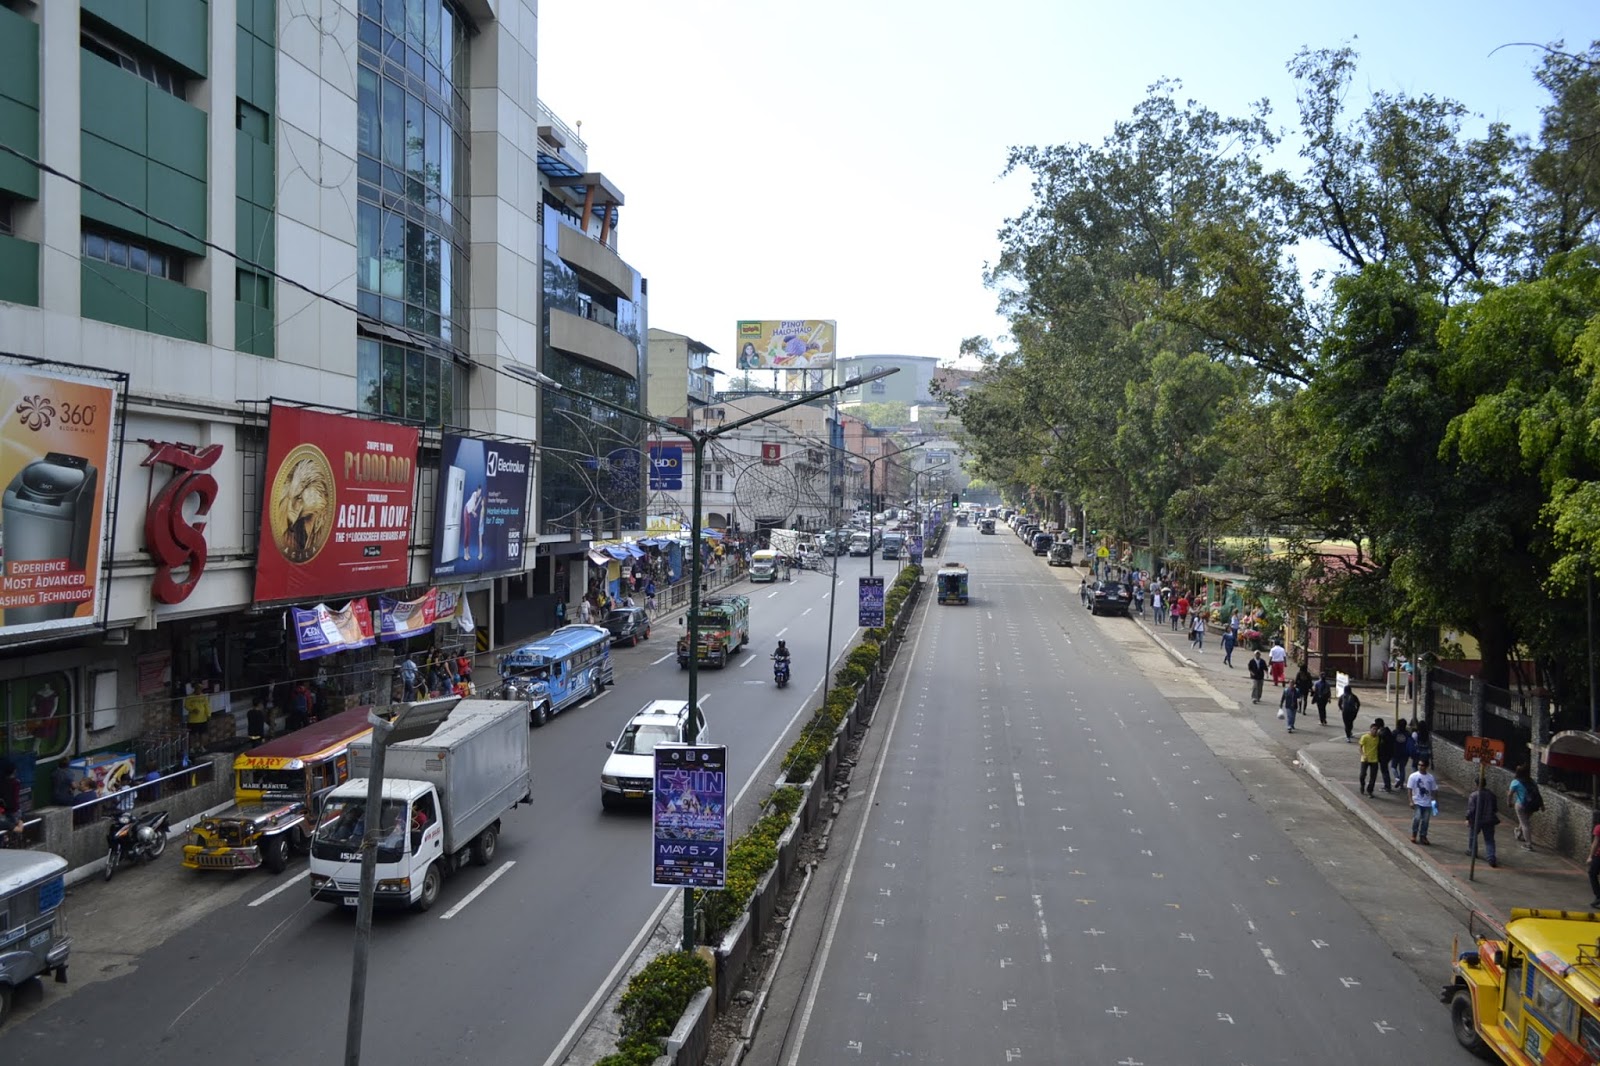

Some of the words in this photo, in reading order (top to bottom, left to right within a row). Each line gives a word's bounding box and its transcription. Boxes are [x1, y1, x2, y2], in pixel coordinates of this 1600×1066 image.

[782, 320, 805, 328] PINOY
[773, 326, 812, 336] HALO-HALO
[367, 441, 379, 451] SWIPE
[498, 458, 525, 473] Electrolux
[654, 458, 678, 468] BDO
[367, 493, 388, 503] DOWNLOAD
[337, 504, 376, 528] AGILA
[380, 505, 409, 528] NOW!
[335, 532, 345, 543] THE
[351, 532, 380, 542] LOCKSCREEN
[380, 531, 399, 541] REWARDS
[399, 530, 407, 540] APP
[508, 543, 519, 557] 100
[12, 561, 66, 574] EXPERIENCE
[4, 577, 33, 590] MOST
[35, 574, 86, 588] ADVANCED
[39, 589, 93, 603] TECHNOLOGY
[246, 758, 283, 766] MARY
[340, 852, 363, 860] ISUZ
[659, 844, 687, 854] MAY
[689, 845, 699, 855] 5
[708, 847, 719, 856] 7
